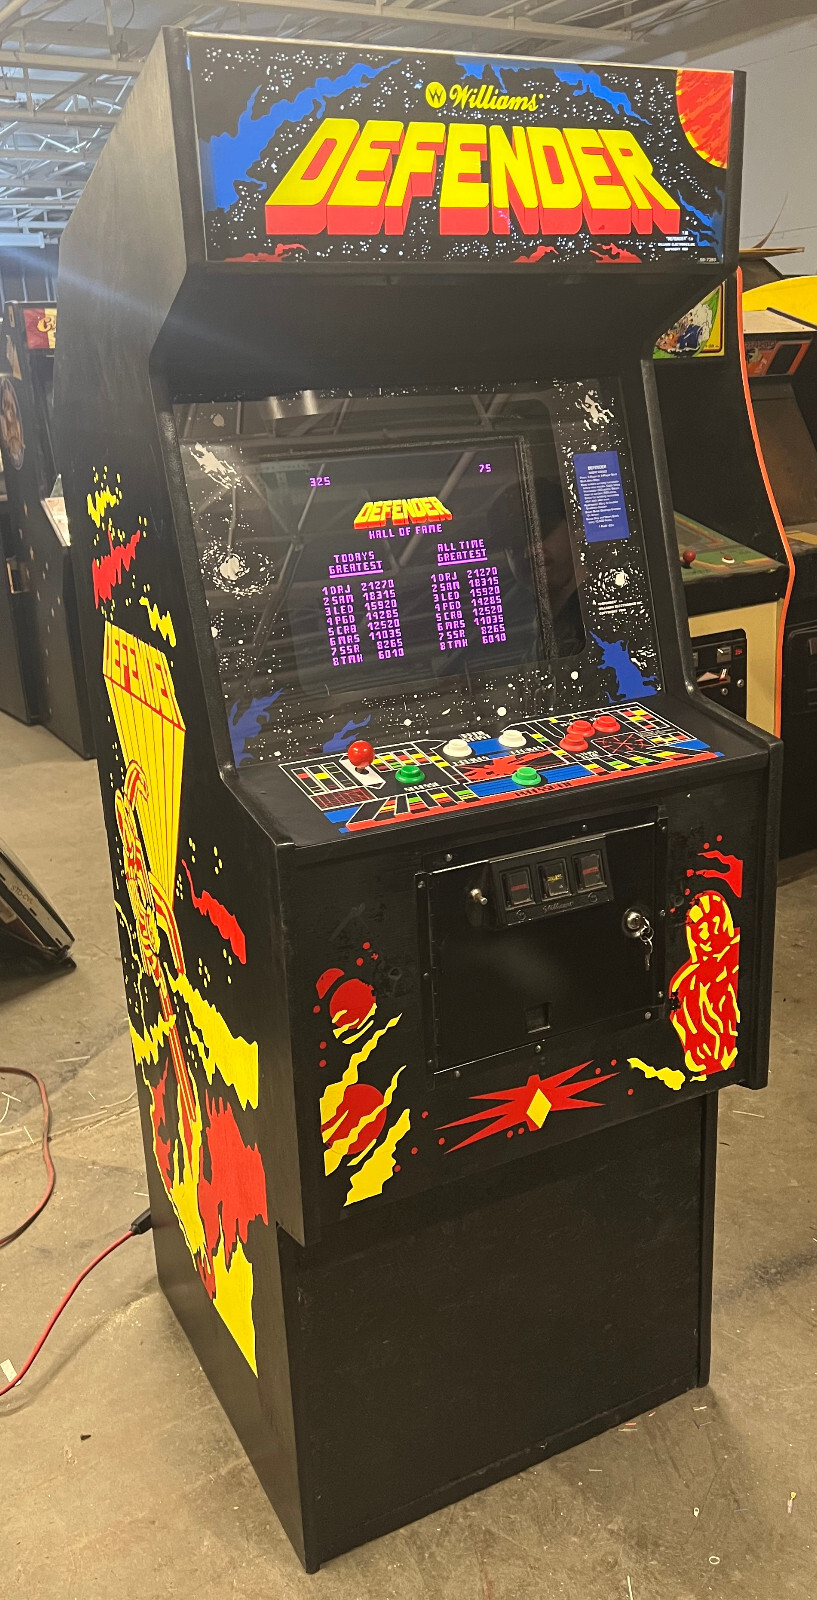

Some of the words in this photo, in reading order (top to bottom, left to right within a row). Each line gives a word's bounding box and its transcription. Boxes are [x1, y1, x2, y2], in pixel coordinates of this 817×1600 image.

[450, 85, 538, 111] Williams
[265, 118, 680, 235] DEFENDER
[479, 464, 491, 473] 75
[309, 477, 330, 486] 325
[354, 496, 452, 529] DEFENDER
[369, 529, 395, 539] HALL
[399, 527, 410, 536] OF
[416, 524, 442, 535] FAME
[438, 543, 456, 552] ALL
[459, 539, 484, 549] TIME
[334, 551, 374, 563] TODAYS
[438, 549, 486, 562] GREATEST
[329, 561, 382, 574] GREATEST
[431, 574, 436, 582] 1
[467, 567, 498, 578] 21270
[322, 587, 328, 595] 1
[361, 579, 394, 591] 21270
[432, 584, 437, 593] 2
[440, 582, 460, 591] SAM
[468, 577, 499, 588] 18315
[323, 597, 330, 606] 2
[332, 594, 354, 604] SAM
[363, 590, 396, 601] 18315
[433, 594, 439, 602] 3
[442, 591, 459, 601] LED
[469, 586, 500, 597] 15920
[471, 596, 501, 606] 14285
[325, 607, 331, 616] 3
[334, 605, 353, 614] LED
[364, 600, 397, 611] 15920
[436, 613, 441, 621] 5
[472, 605, 502, 616] 12520
[327, 617, 333, 625] 4
[366, 609, 399, 620] 14285
[437, 622, 443, 632] 6
[445, 620, 465, 630] MRS
[474, 615, 504, 626] 11035
[328, 627, 334, 636] 5
[367, 619, 400, 630] 12520
[439, 632, 444, 640] 7
[447, 630, 465, 639] SSR
[481, 624, 505, 635] 8265
[329, 637, 336, 646] 6
[338, 634, 360, 645] MRS
[369, 629, 401, 640] 11035
[440, 642, 446, 650] 8
[447, 639, 468, 648] TMH
[482, 633, 506, 644] 6010
[331, 647, 337, 656] 7
[340, 645, 360, 655] SSR
[376, 639, 403, 650] 8265
[332, 657, 339, 666] 8
[340, 654, 363, 665] TMH
[378, 648, 404, 660] 6010
